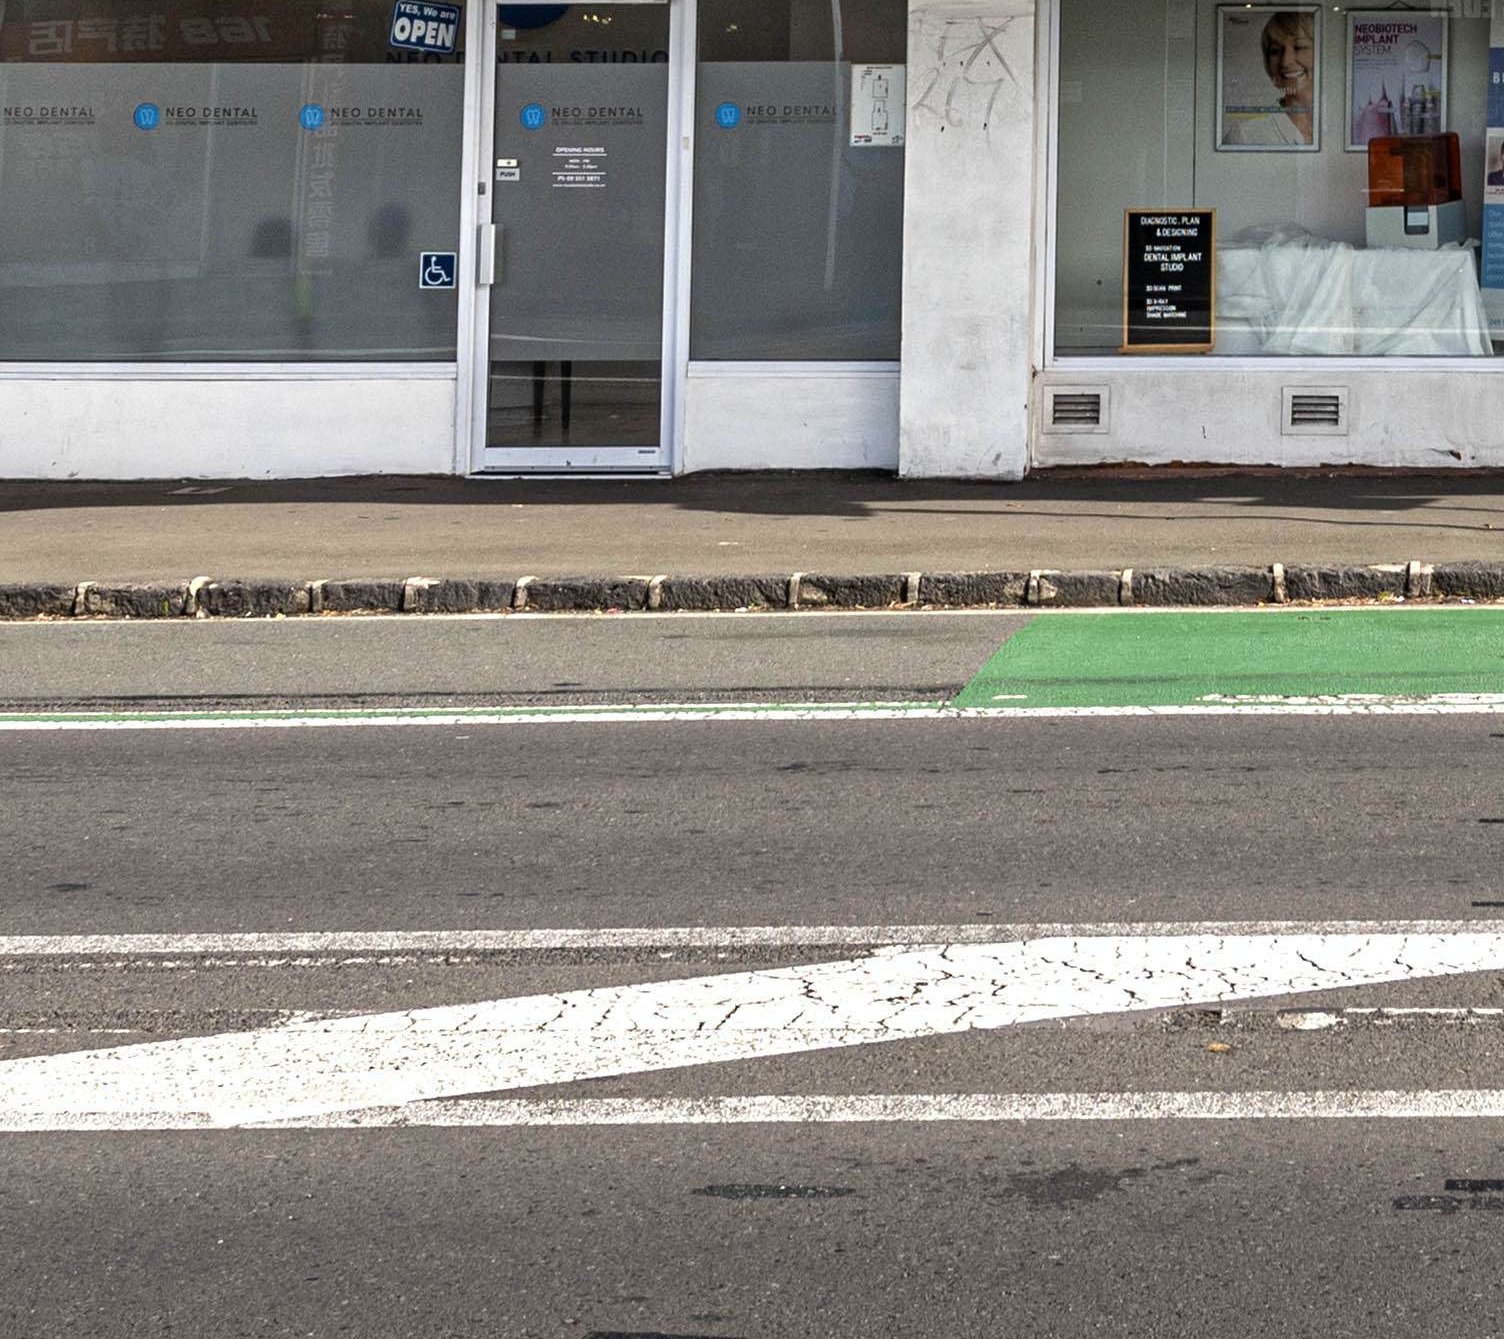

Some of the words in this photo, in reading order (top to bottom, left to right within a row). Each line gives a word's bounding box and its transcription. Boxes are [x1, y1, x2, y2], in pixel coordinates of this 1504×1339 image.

[399, 2, 421, 15] YES,
[423, 6, 438, 18] We
[439, 9, 456, 20] are
[394, 17, 455, 48] OPEN
[1355, 24, 1417, 34] NEOBIOTECH
[1355, 34, 1400, 44] IMPLANT
[1355, 45, 1392, 55] SYSTEM
[4, 107, 33, 117] NEO
[40, 107, 95, 117] DENTAL
[166, 107, 195, 117] NEO
[203, 107, 258, 117] DENTAL
[330, 107, 360, 117] NEO
[367, 107, 423, 117] DENTAL
[552, 107, 582, 117] NEO
[588, 107, 643, 117] DENTAL
[747, 106, 777, 116] NEO
[783, 106, 837, 116] DENTAL
[1182, 216, 1200, 225] PLAN
[1144, 253, 1169, 262] DENTAL
[1171, 253, 1202, 262] IMPLANT
[1161, 263, 1184, 271] STUDIO
